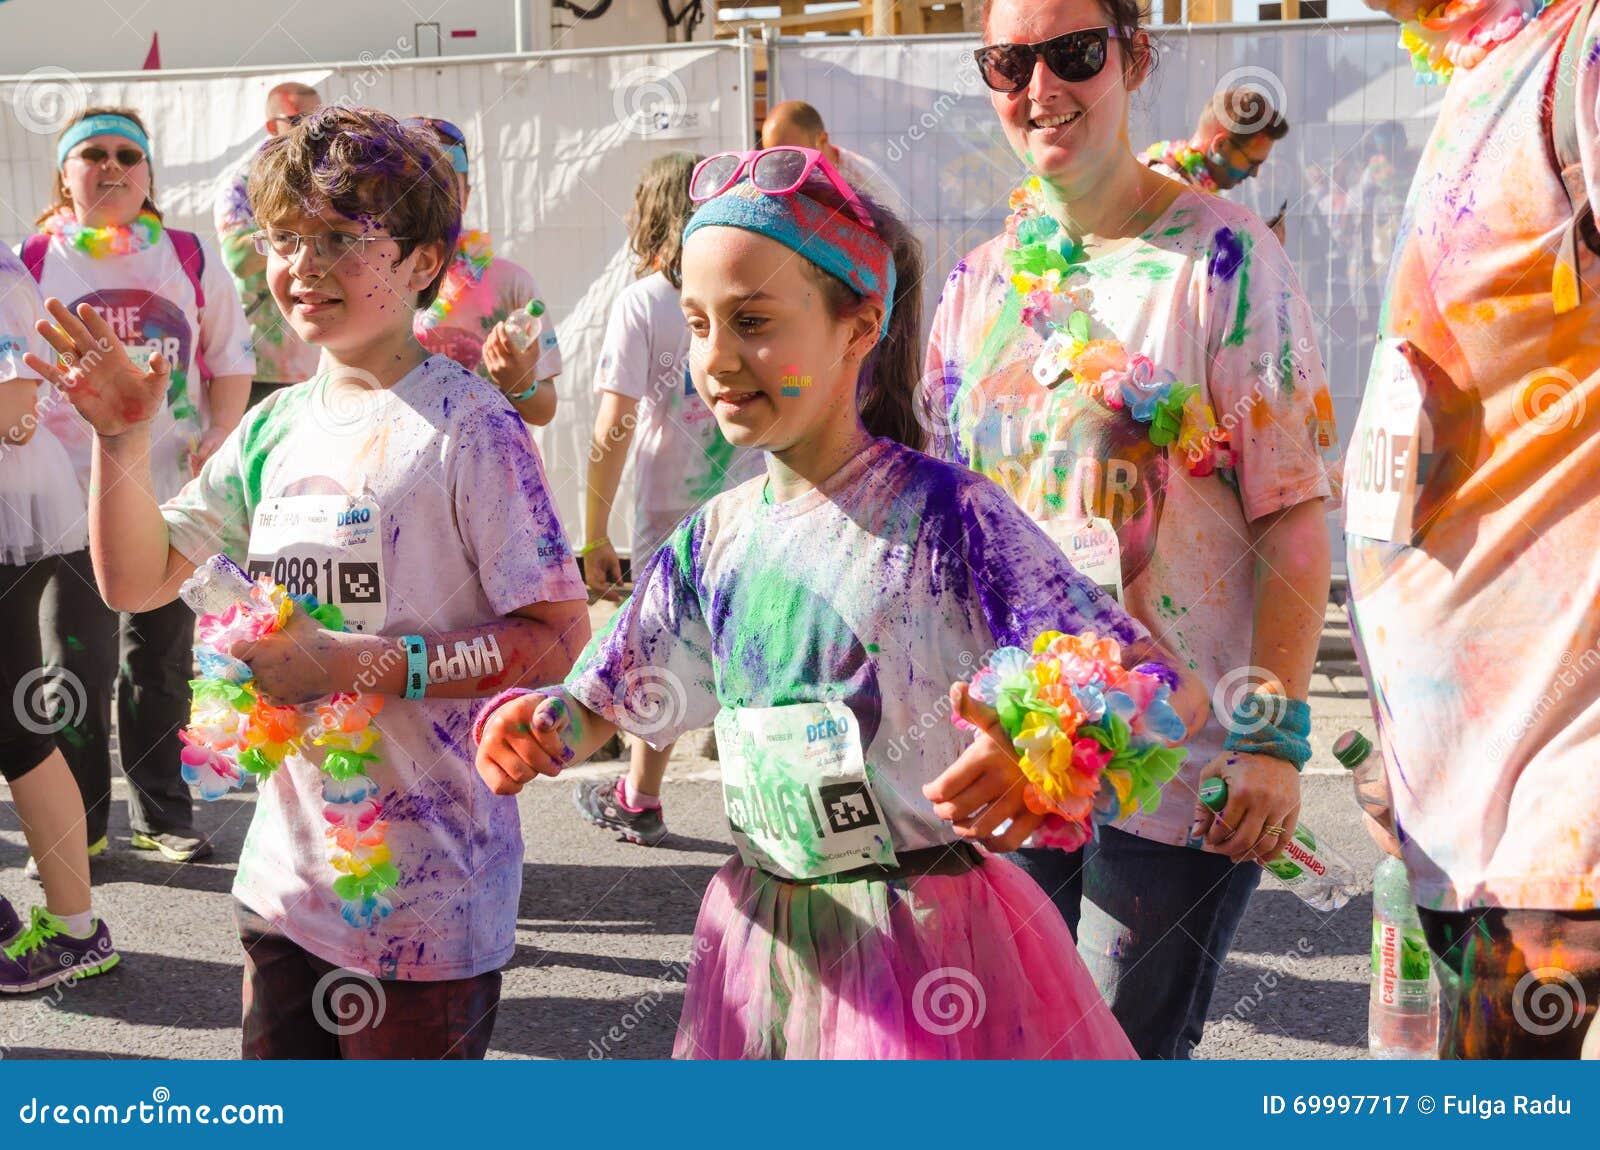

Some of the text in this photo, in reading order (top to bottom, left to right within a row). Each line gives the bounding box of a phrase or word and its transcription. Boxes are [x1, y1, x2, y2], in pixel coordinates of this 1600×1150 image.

[337, 508, 370, 527] DERO
[427, 634, 505, 685] HAPP
[806, 716, 849, 743] DERO
[1382, 926, 1398, 1005] carpatina
